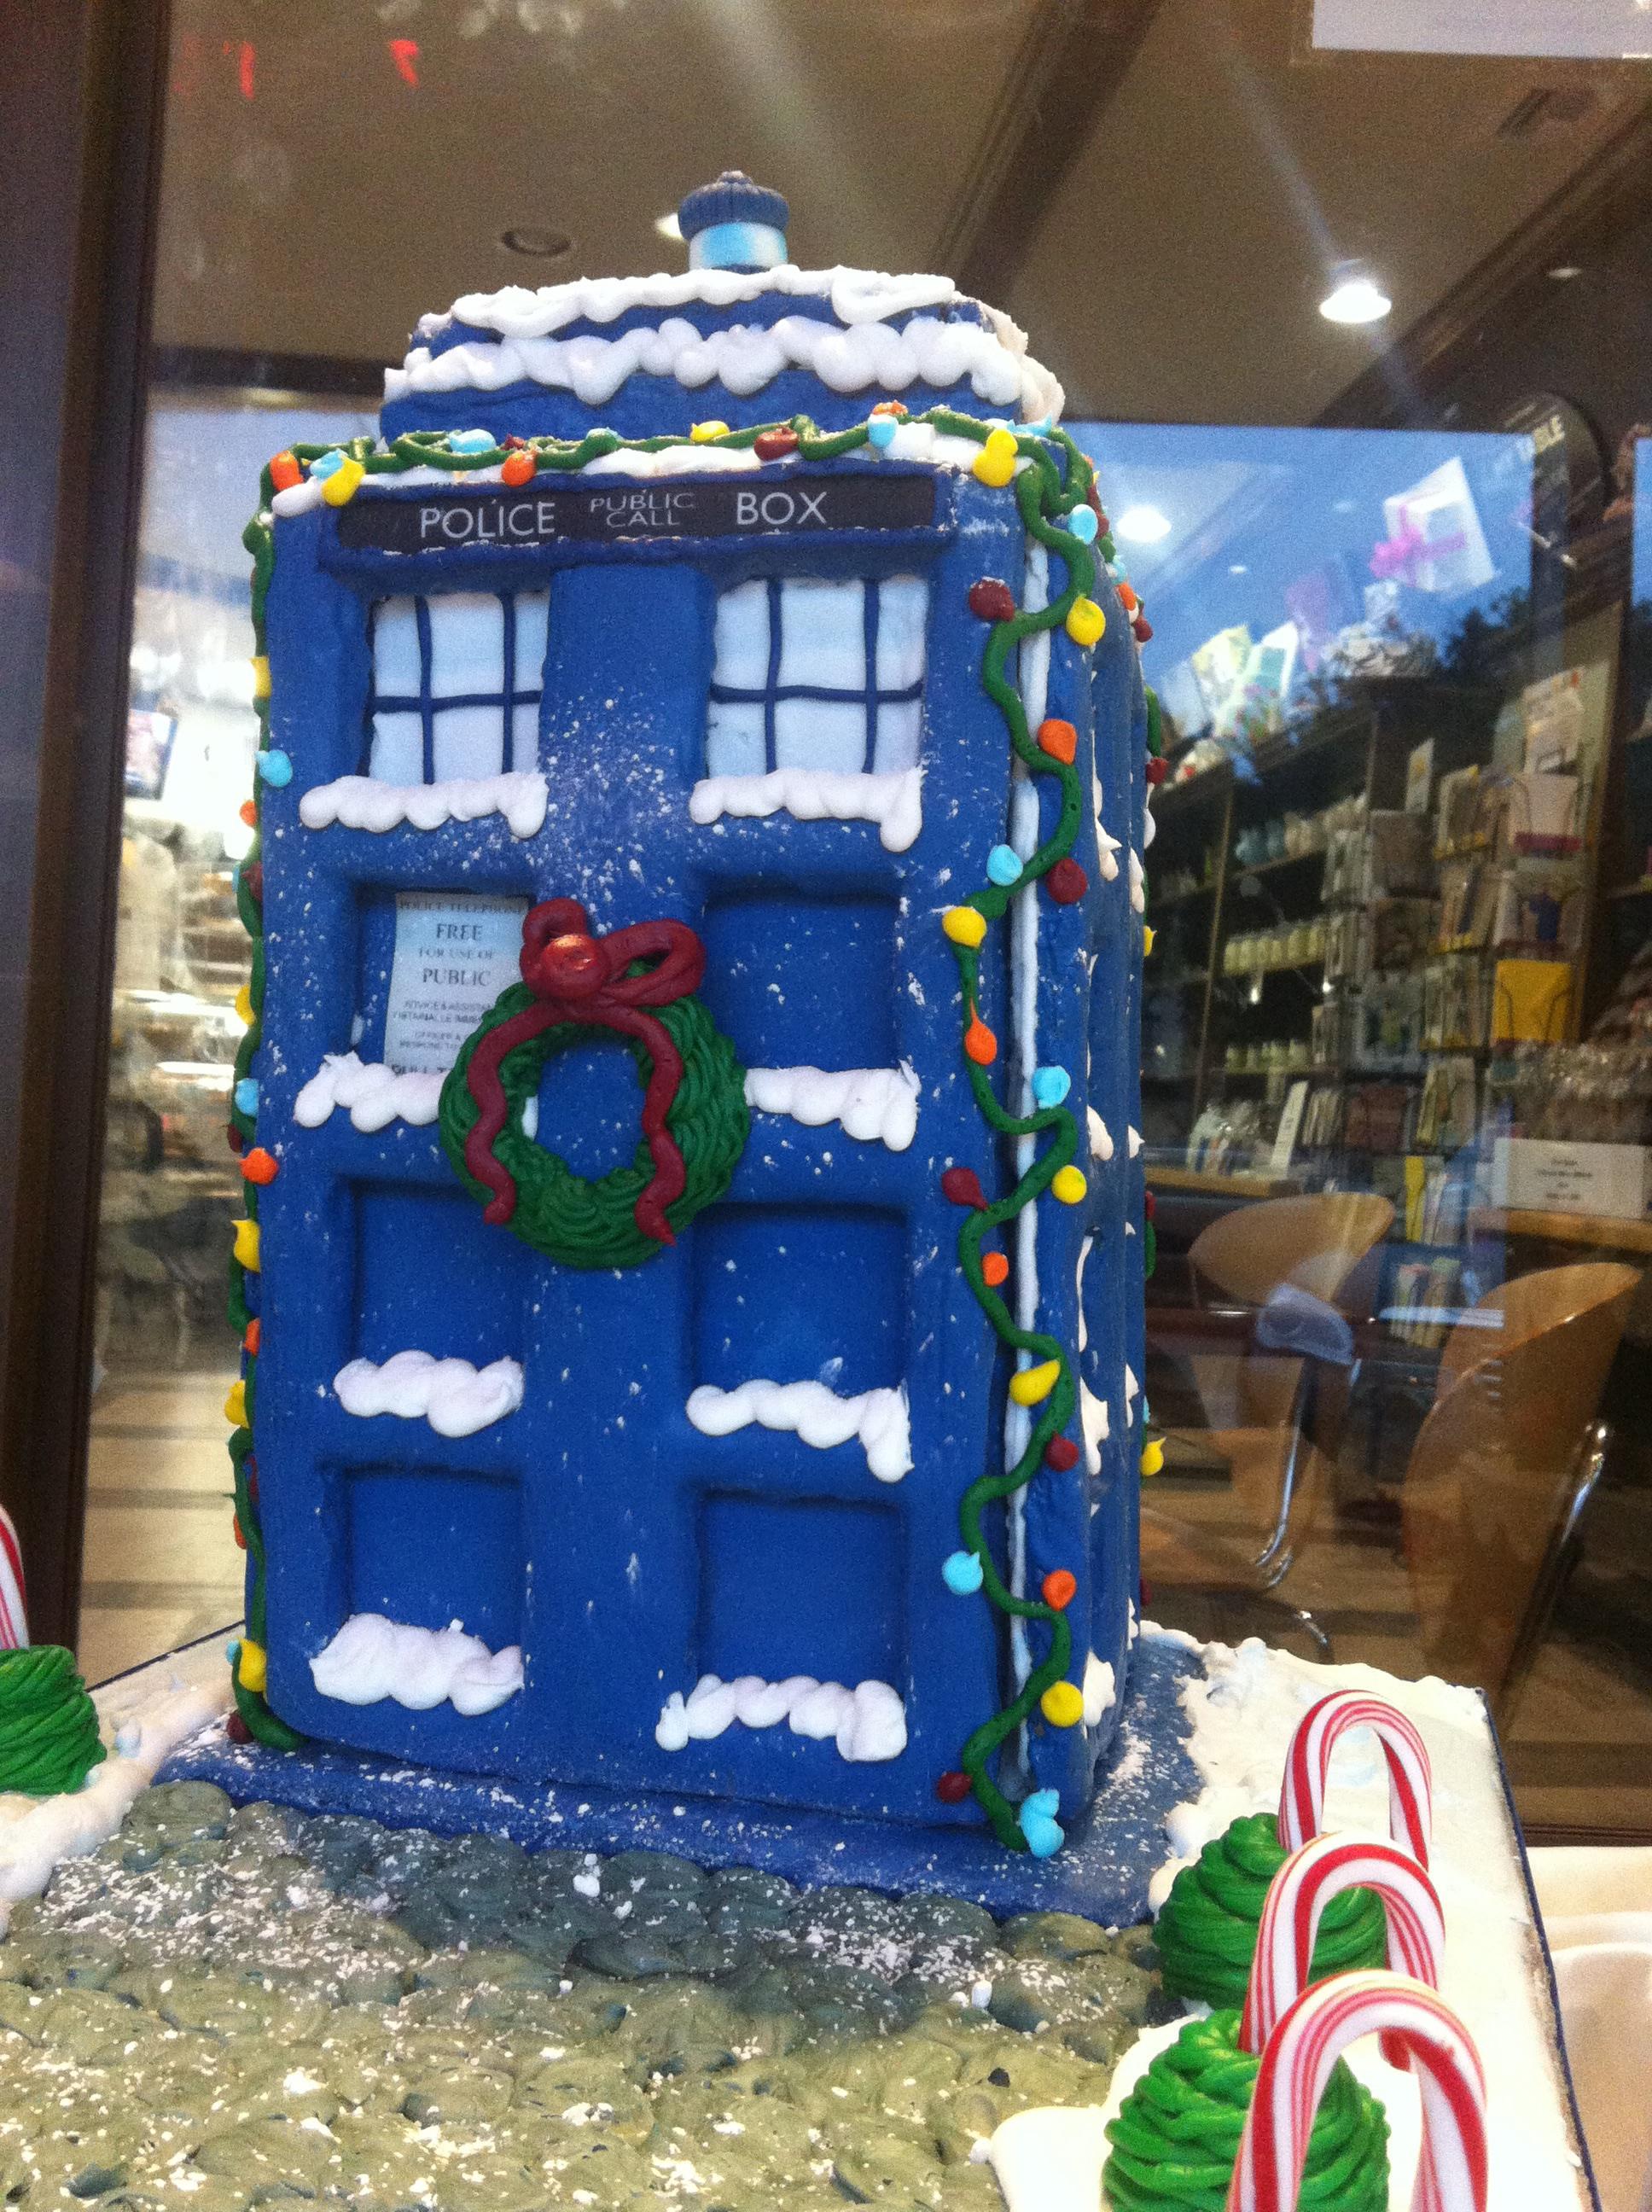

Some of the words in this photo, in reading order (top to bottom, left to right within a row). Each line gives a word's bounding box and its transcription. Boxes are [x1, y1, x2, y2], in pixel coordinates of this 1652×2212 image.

[590, 492, 695, 512] PUBLIC
[736, 491, 828, 525] BOX
[420, 501, 556, 538] POLICE
[606, 510, 682, 527] CALL
[436, 923, 483, 940] FREE
[422, 968, 492, 987] PUBLIC
